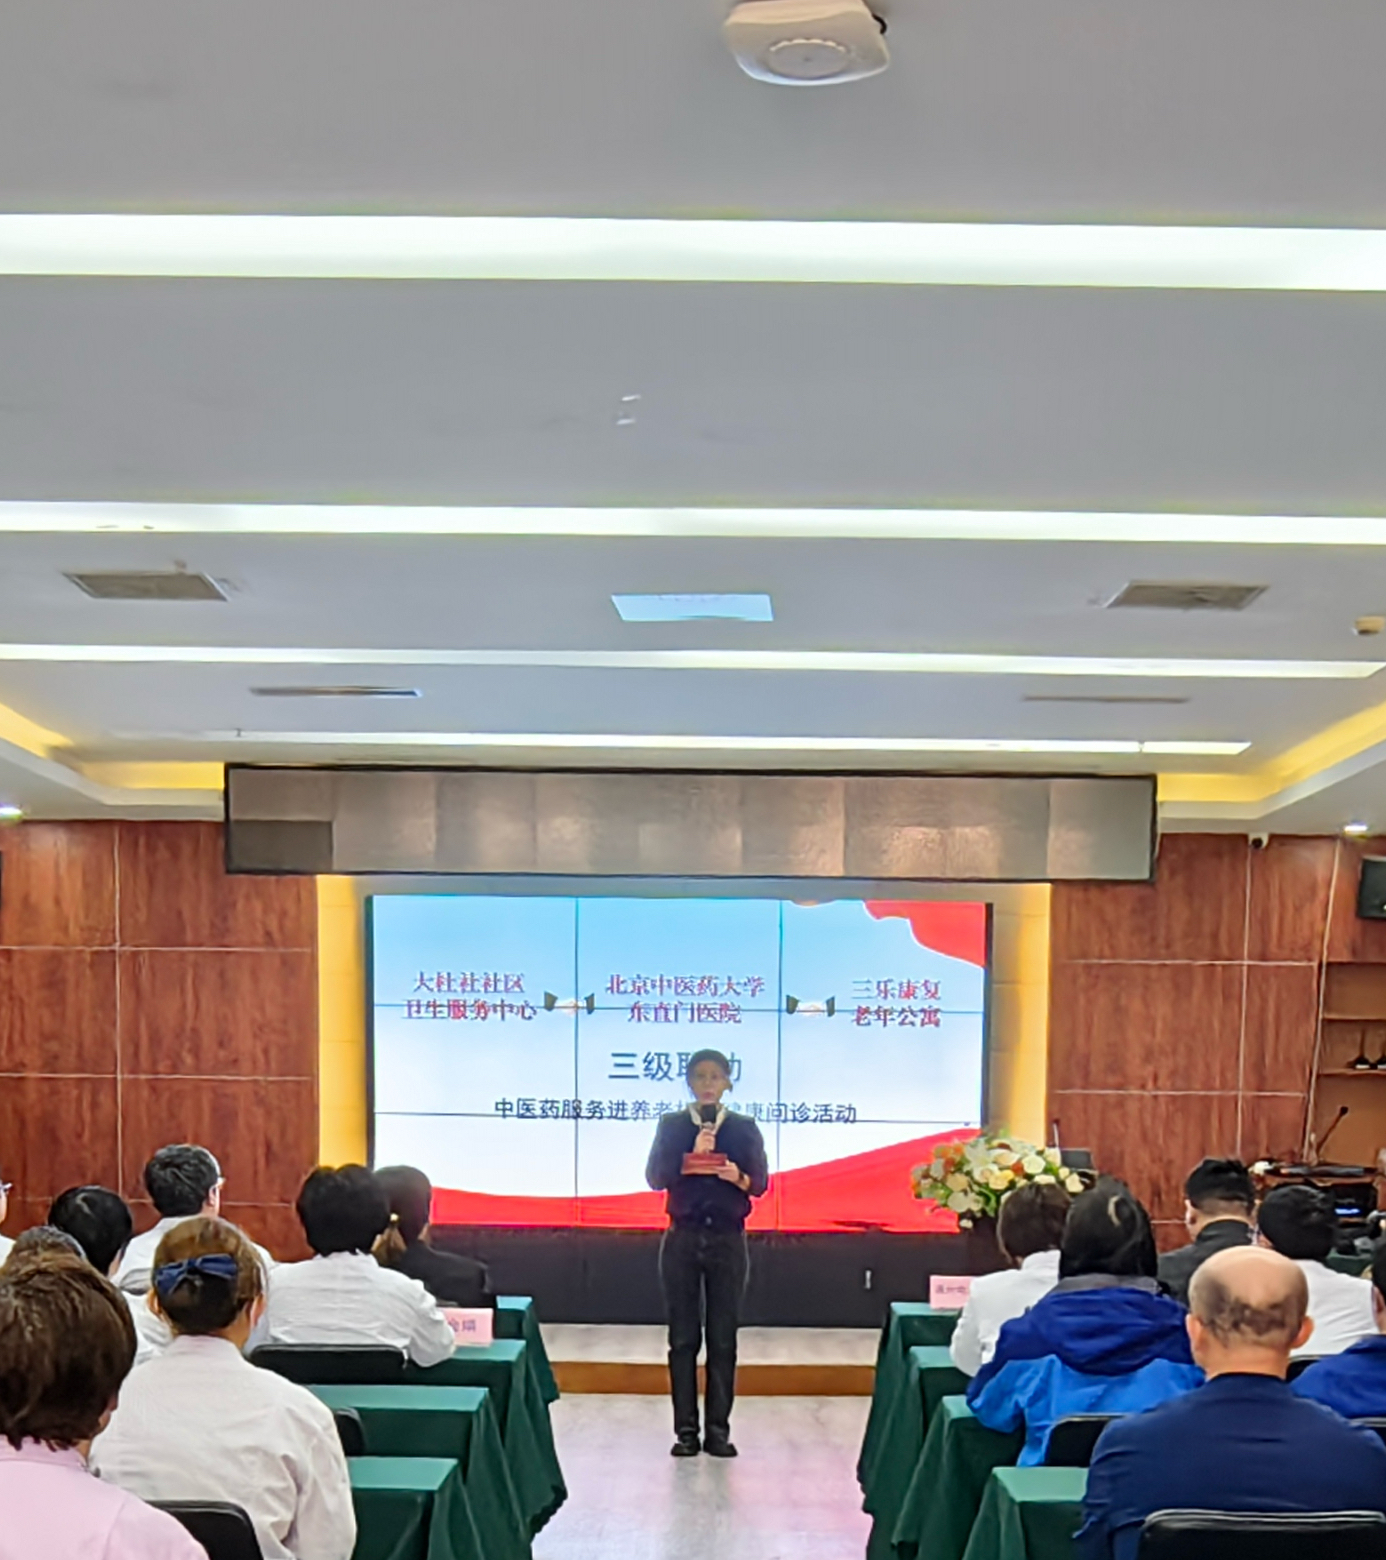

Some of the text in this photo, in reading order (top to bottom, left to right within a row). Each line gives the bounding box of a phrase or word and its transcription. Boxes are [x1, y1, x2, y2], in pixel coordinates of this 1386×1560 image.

[413, 971, 525, 994] 大杜社社区
[605, 973, 765, 998] 北京中医药大学
[851, 978, 943, 1001] 三乐康复
[405, 998, 537, 1022] 卫生服务中心
[627, 1000, 743, 1024] 东直门医院
[851, 1004, 943, 1028] 老年公寓
[494, 1097, 857, 1125] 中医药服务进养老康问诊活动
